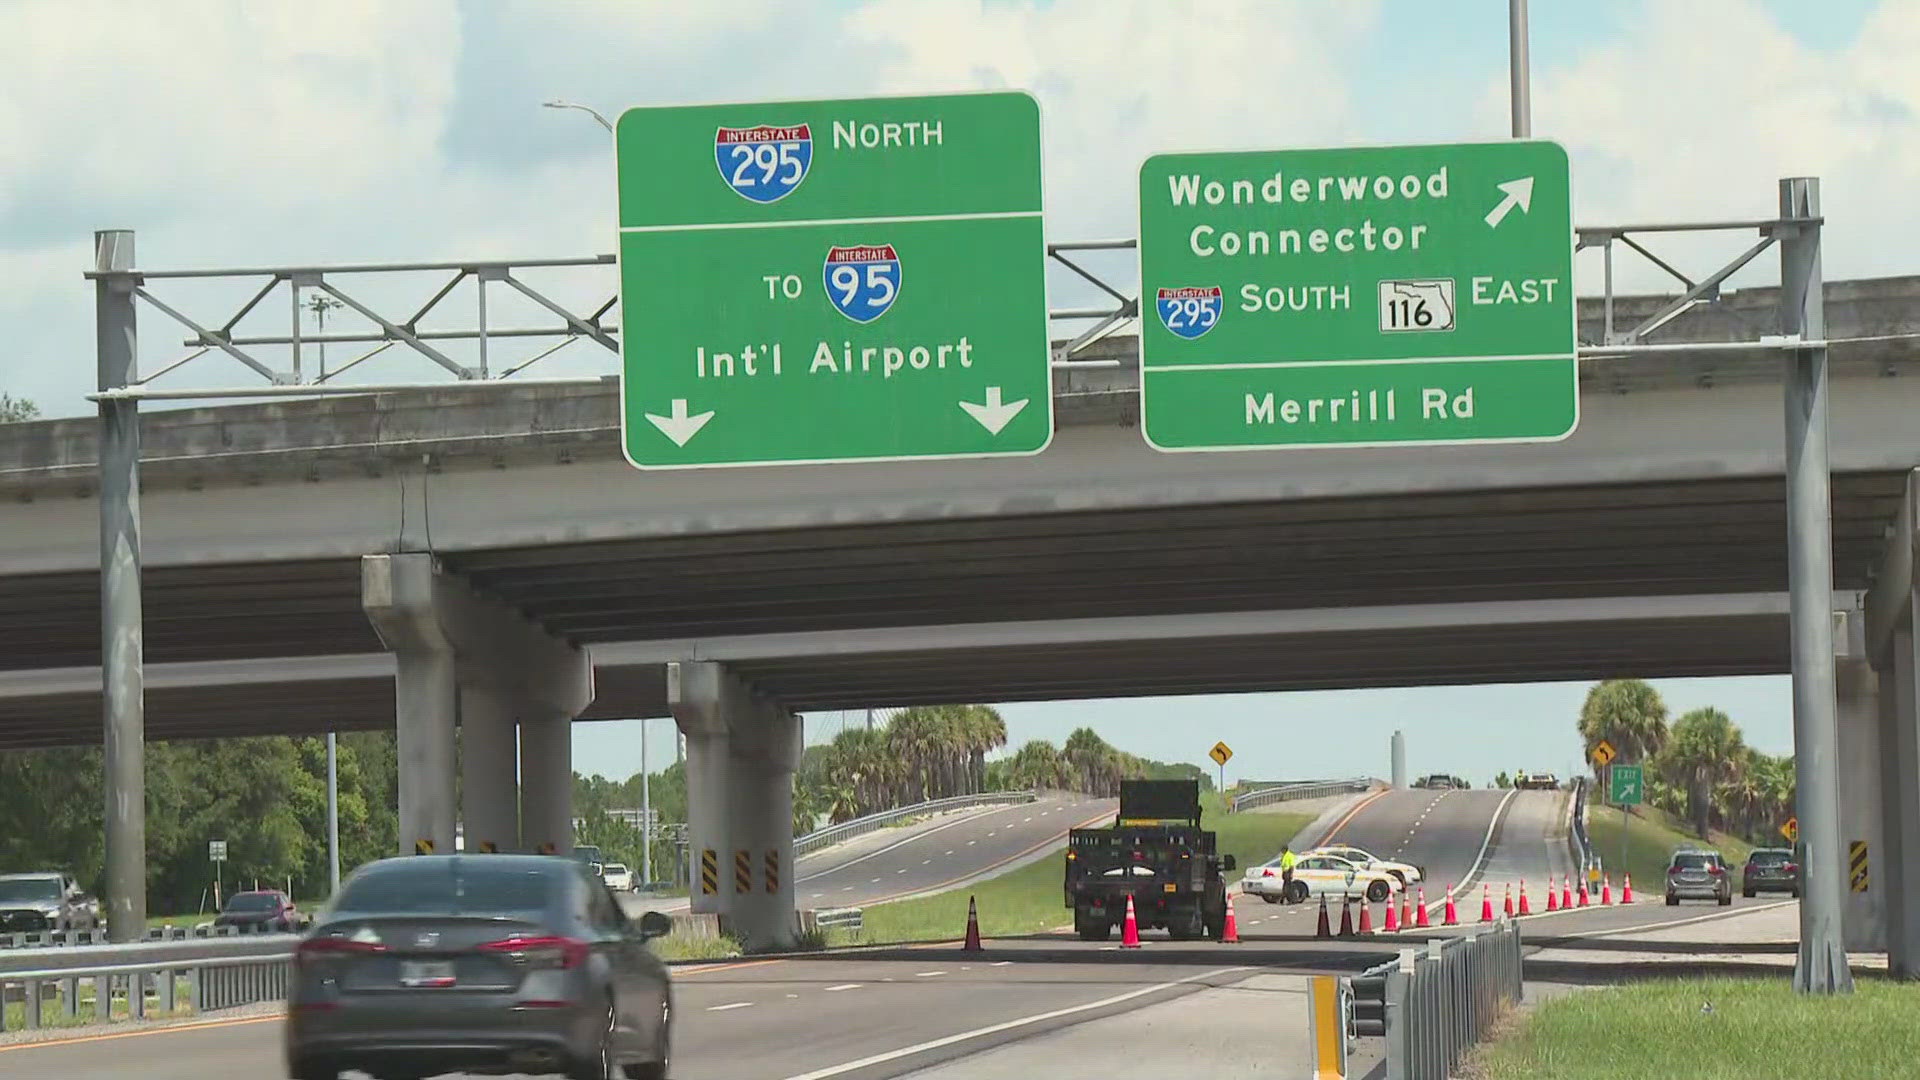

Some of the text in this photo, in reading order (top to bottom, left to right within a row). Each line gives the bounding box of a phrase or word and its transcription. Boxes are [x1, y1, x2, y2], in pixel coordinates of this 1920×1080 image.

[726, 128, 800, 143] INTERSTATE
[731, 120, 943, 187] 295 NORTH
[1168, 166, 1449, 206] Wonderwood
[835, 249, 888, 262] INTERSTATE
[1190, 219, 1427, 257] Connector
[763, 265, 895, 308] TO 95
[1163, 288, 1215, 298] INTERSTATE
[1167, 276, 1559, 329] 295 SOUTH 116 EAST
[697, 336, 974, 379] Int'l Airport
[1245, 387, 1474, 424] Merrill Rd
[1617, 769, 1636, 780] EXIT
